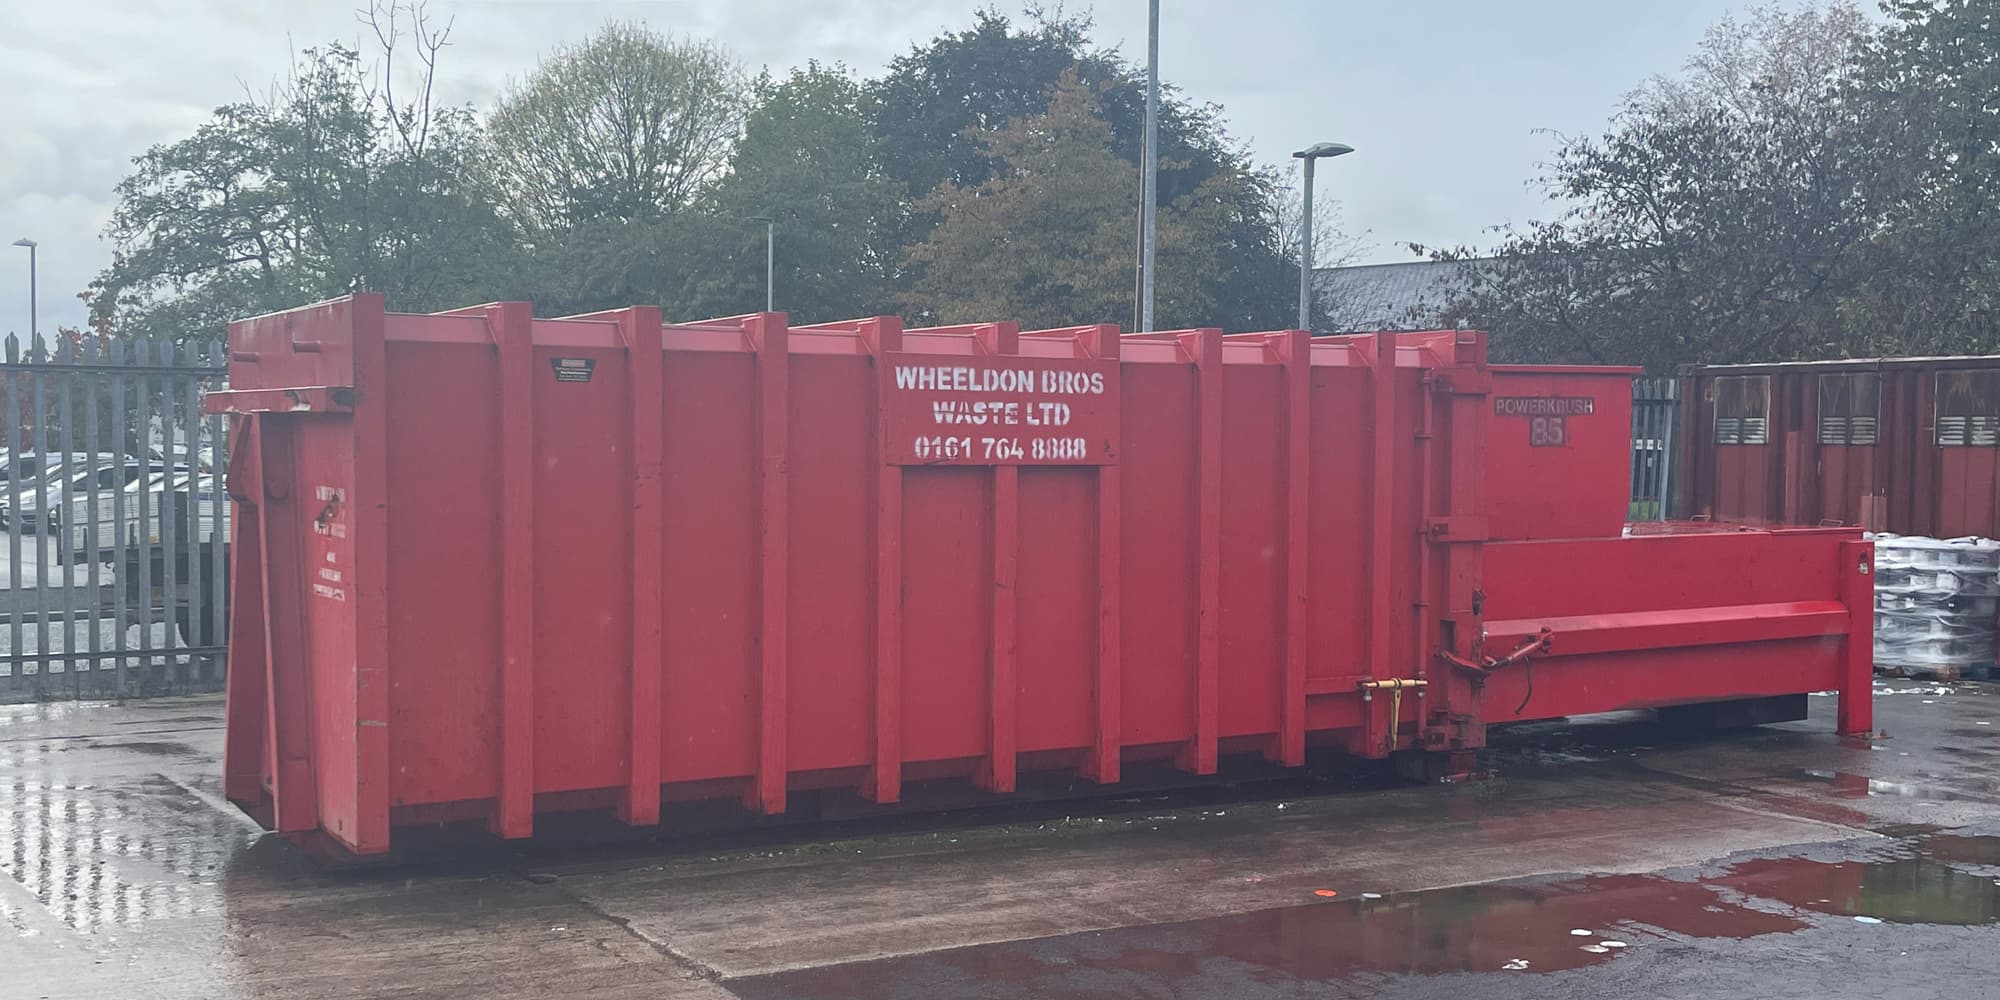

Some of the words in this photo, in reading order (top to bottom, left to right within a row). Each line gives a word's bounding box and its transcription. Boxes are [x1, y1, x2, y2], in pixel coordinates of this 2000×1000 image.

[895, 366, 1034, 393] WHEELDON
[1042, 370, 1104, 394] BROS
[933, 401, 1019, 425] WASTE
[1026, 402, 1070, 426] LTD
[1495, 398, 1593, 414] POWERKRUSH
[1531, 417, 1564, 445] 85
[914, 436, 972, 460] 0161
[981, 437, 1024, 460] 764
[1031, 437, 1087, 460] 8888
